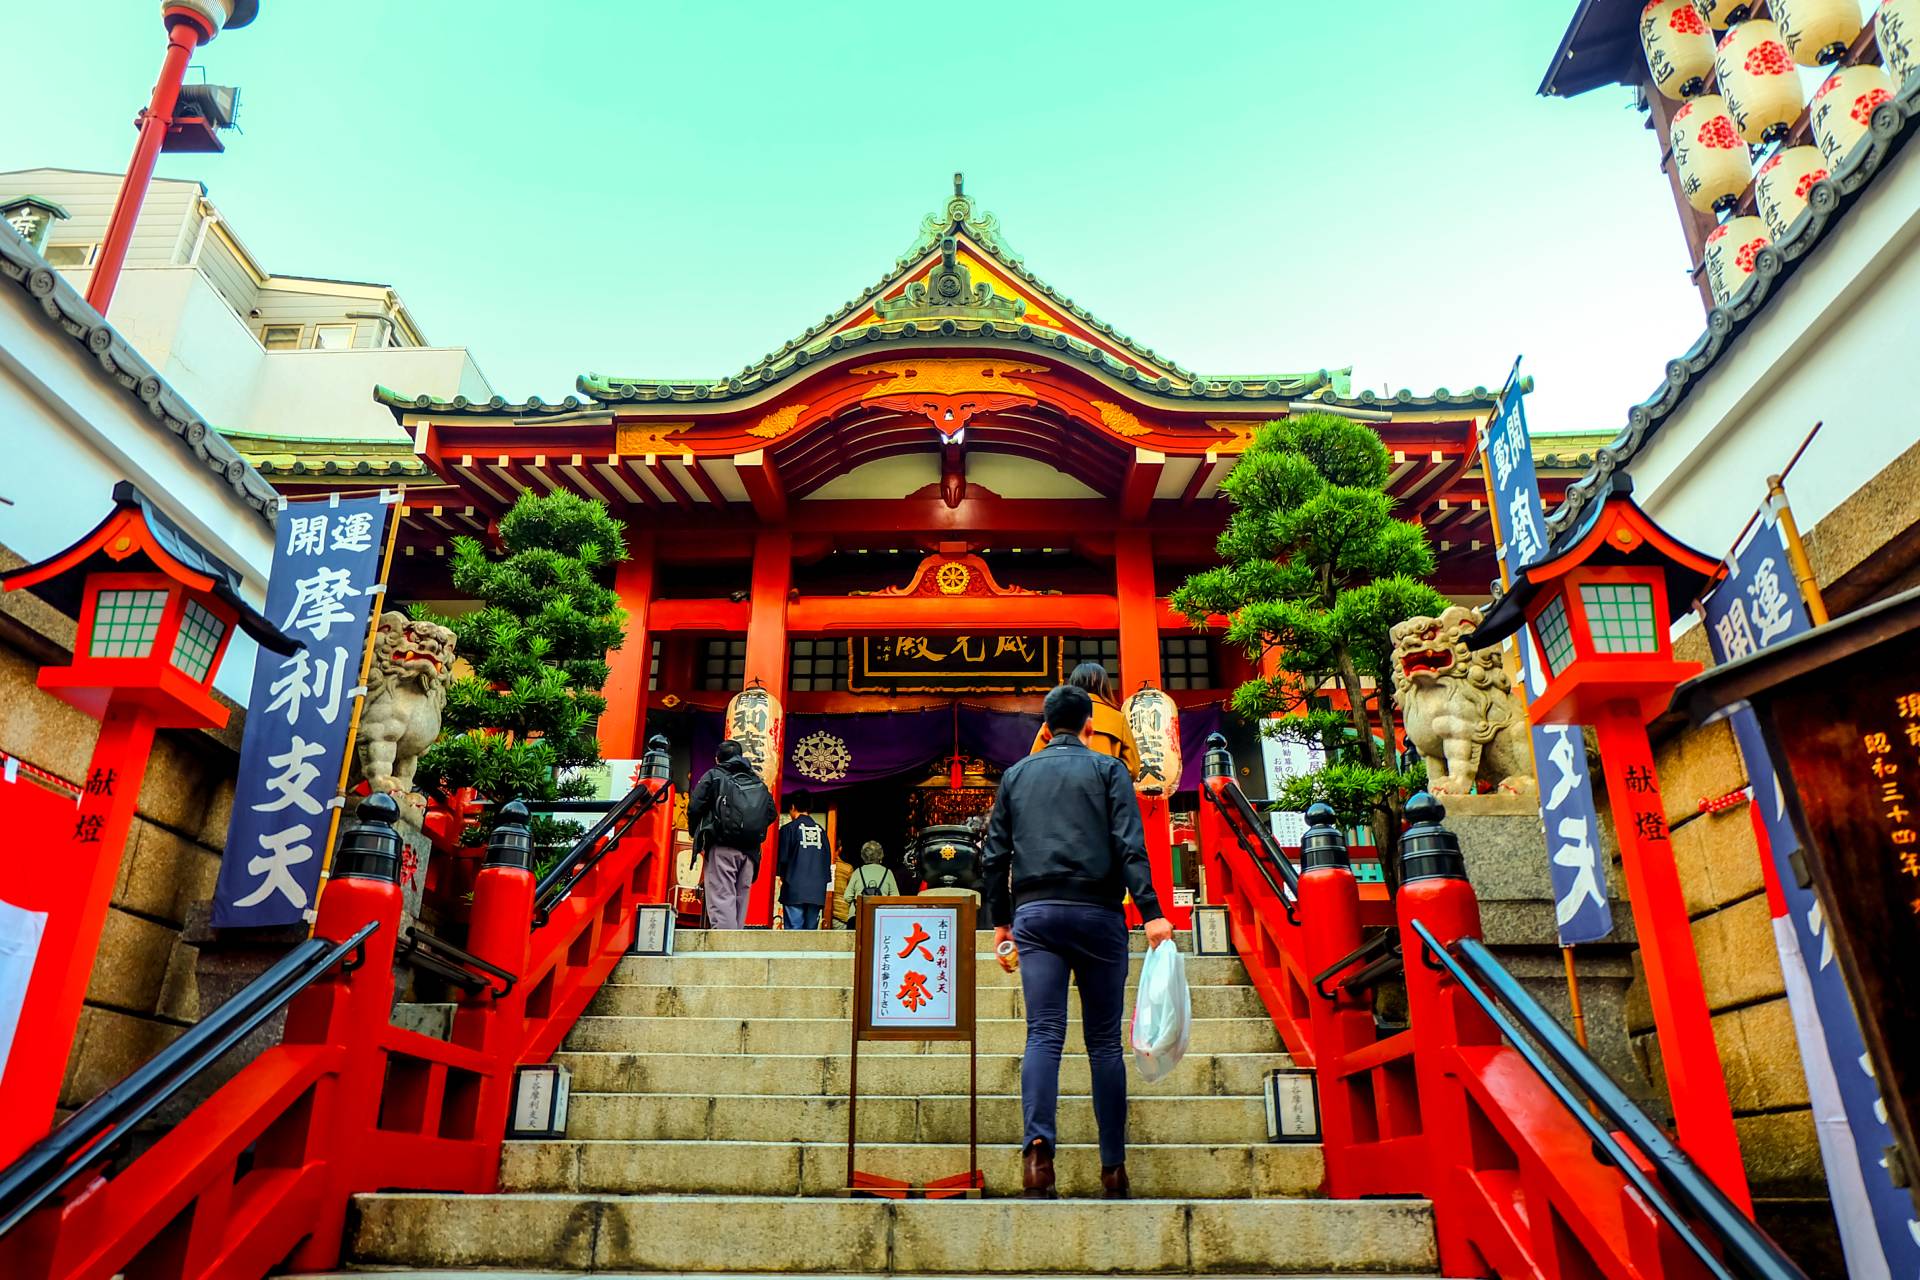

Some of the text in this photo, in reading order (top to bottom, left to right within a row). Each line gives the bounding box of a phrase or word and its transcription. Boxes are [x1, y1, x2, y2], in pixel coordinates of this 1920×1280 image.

[286, 511, 375, 557] 開運
[1715, 557, 1793, 663] 開運
[232, 566, 362, 909] 摩利支天
[896, 922, 934, 1013] 大祭
[938, 919, 948, 940] 本日
[880, 935, 891, 1016] どうぞお参り下さい
